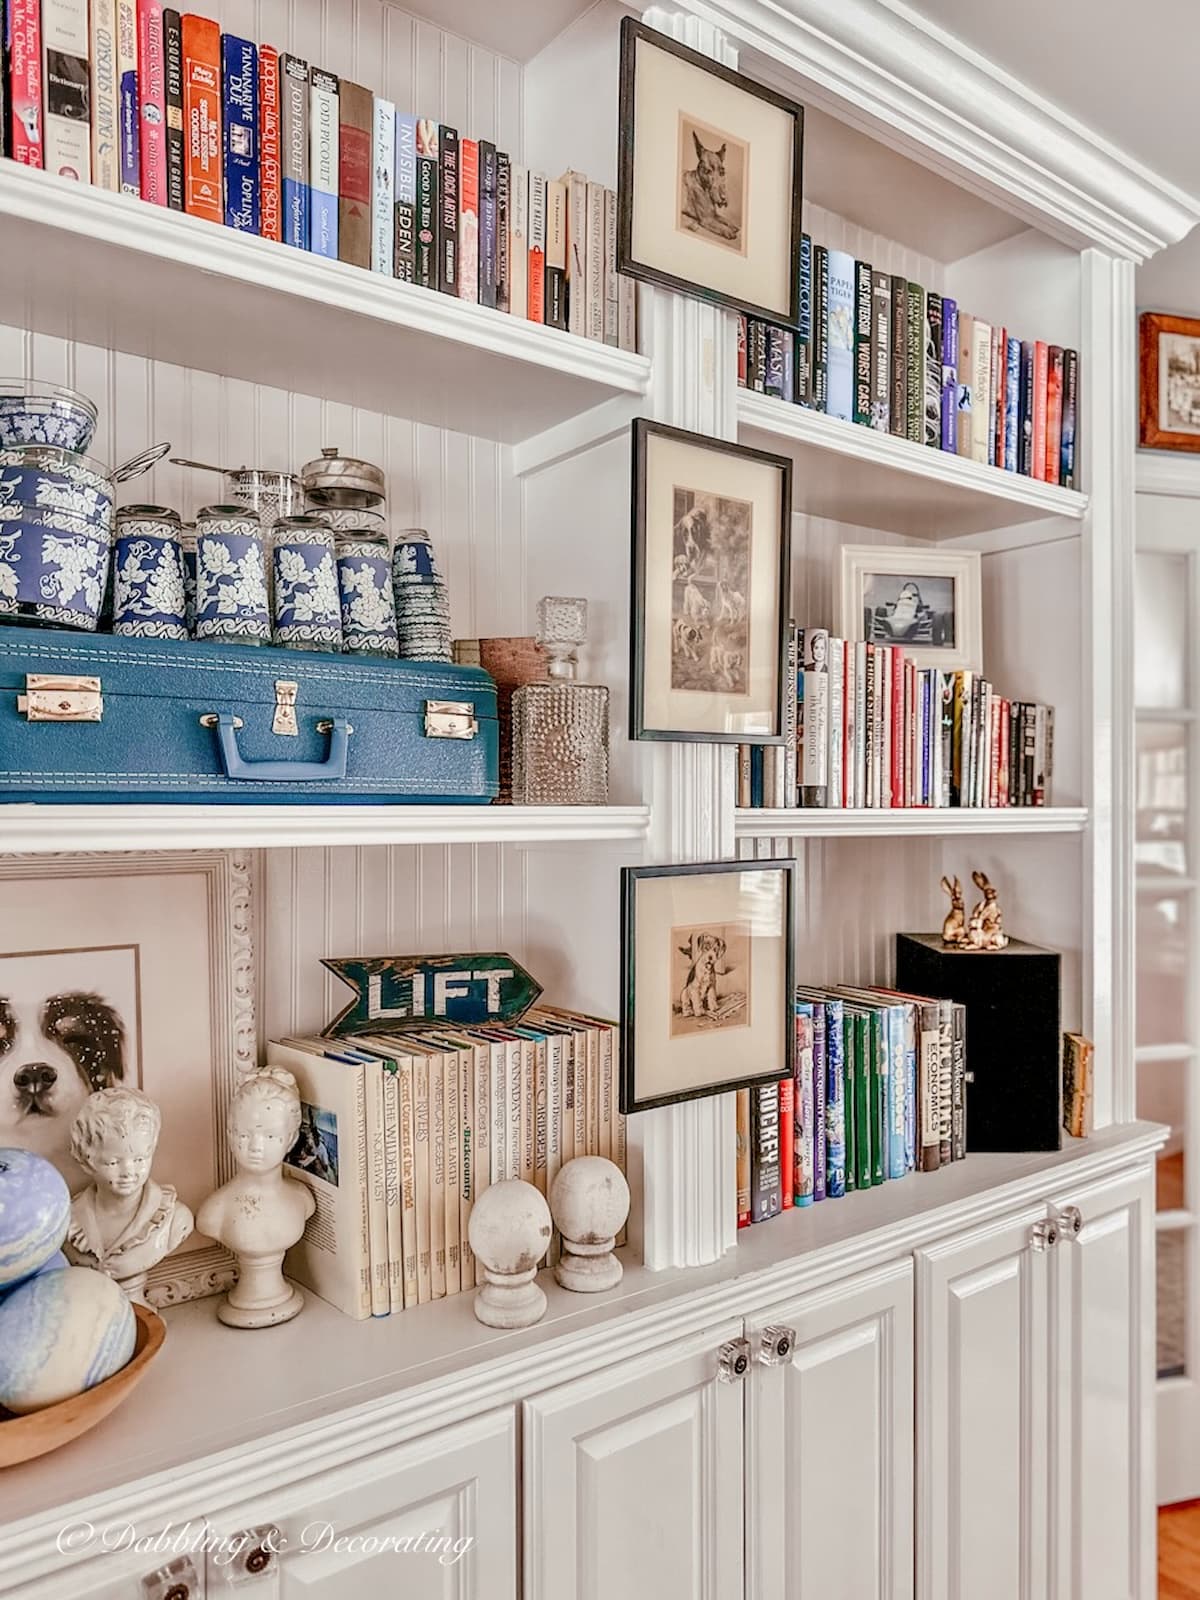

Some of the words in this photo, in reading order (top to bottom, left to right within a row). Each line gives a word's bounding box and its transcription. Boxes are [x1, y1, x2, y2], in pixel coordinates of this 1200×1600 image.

[14, 7, 25, 29] Me,
[26, 18, 37, 54] There,
[119, 13, 127, 57] ALCOHOLICS
[14, 32, 25, 76] Chelsea
[148, 15, 161, 60] Marley
[96, 28, 113, 93] CONSCIOUS
[149, 61, 161, 75] &
[168, 28, 180, 95] E-SQUARED
[27, 60, 38, 101] Vodka?
[49, 73, 85, 91] Dictionary
[150, 77, 161, 99] Me
[229, 75, 241, 105] DUE
[240, 46, 253, 122] TANANARIVE
[262, 58, 277, 106] Landorf
[289, 82, 303, 116] JODI
[98, 94, 113, 139] LOVING
[199, 98, 209, 132] SUPERB
[263, 110, 277, 142] Town
[318, 95, 330, 125] JODI
[171, 140, 182, 163] PAM
[191, 108, 200, 158] COOKBOOK
[208, 120, 218, 157] McCall's
[290, 116, 303, 177] PICOULT
[200, 133, 209, 172] DESSERT
[263, 155, 280, 185] Lady
[319, 126, 330, 184] PICOULT
[399, 123, 413, 202] INVISIBLE
[444, 149, 456, 167] THE
[171, 167, 183, 203] GROUT
[421, 160, 432, 191] GOOD
[444, 169, 456, 194] LOCK
[484, 165, 494, 191] Dogs
[498, 156, 509, 210] EMBERS
[533, 176, 543, 208] SHIRLEY
[241, 175, 254, 227] JOPLIN'S
[263, 187, 278, 233] Richest
[421, 192, 431, 205] IN
[421, 206, 432, 228] BED
[444, 194, 457, 231] ARTIST
[485, 201, 495, 231] Babel
[398, 205, 412, 253] EDEN
[533, 209, 543, 241] HAZZARD
[592, 198, 600, 237] PURSUIT
[592, 246, 601, 299] HAPPYNESS
[799, 239, 811, 276] JODI
[858, 264, 871, 293] JAMES
[895, 286, 905, 306] The
[799, 276, 811, 339] PICOULT
[858, 293, 870, 337] PATTERSON
[876, 313, 888, 350] JIMMY
[895, 307, 904, 352] Rainmaker
[770, 336, 783, 386] MASK
[858, 342, 870, 384] WORST
[894, 358, 904, 380] John
[907, 355, 914, 366] TO
[979, 339, 990, 362] World
[876, 350, 888, 398] CONNORS
[976, 363, 990, 404] Mythology
[857, 384, 869, 415] CASE
[894, 382, 904, 418] Grisham
[866, 656, 875, 693] THINK
[809, 695, 817, 722] HARD
[809, 724, 817, 766] CHOICES
[367, 969, 514, 1021] LIFT
[447, 1059, 457, 1086] OUR
[478, 1054, 488, 1072] The
[496, 1054, 505, 1074] Blue
[525, 1050, 534, 1076] Along
[551, 1046, 561, 1094] Pathways
[604, 1053, 614, 1080] Rural
[816, 1051, 824, 1080] TOTAL
[356, 1072, 365, 1117] VOYAGES
[385, 1076, 396, 1100] NTO
[400, 1070, 410, 1105] Secret
[478, 1073, 488, 1104] Pacific
[494, 1075, 505, 1101] Ridge
[511, 1050, 521, 1122] CANADA'S
[525, 1076, 534, 1091] the
[552, 1094, 561, 1105] to
[576, 1060, 585, 1117] AMERICA'S
[816, 1080, 824, 1116] QUALITY
[930, 1043, 939, 1132] ECONOMICS
[938, 1023, 953, 1142] SOCIOLOGY
[954, 1061, 964, 1106] Welcome
[386, 1100, 396, 1122] THE
[415, 1101, 429, 1142] RIVERS
[434, 1075, 444, 1133] AMERICAN
[448, 1087, 457, 1145] AWESOME
[478, 1105, 487, 1131] Crest
[494, 1102, 504, 1129] Range
[525, 1092, 534, 1141] Continental
[603, 1084, 612, 1122] America
[401, 1106, 412, 1147] Corners
[478, 1132, 488, 1149] Trail
[536, 1088, 548, 1171] CARIBBEAN
[551, 1106, 561, 1154] Discovery
[576, 1118, 585, 1145] PAST
[759, 1084, 779, 1164] HOCKEY
[357, 1132, 366, 1185] PARADISE
[402, 1148, 413, 1161] of
[435, 1135, 444, 1185] DESERTS
[511, 1126, 521, 1171] Incredible
[525, 1143, 534, 1170] Divide
[816, 1117, 824, 1172] MANAGEMENT
[374, 1131, 384, 1203] NORTHWEST
[386, 1123, 398, 1207] WILDERNESS
[403, 1162, 413, 1178] the
[448, 1147, 458, 1187] EARTH
[462, 1126, 472, 1201] Backcountry
[404, 1178, 414, 1210] World
